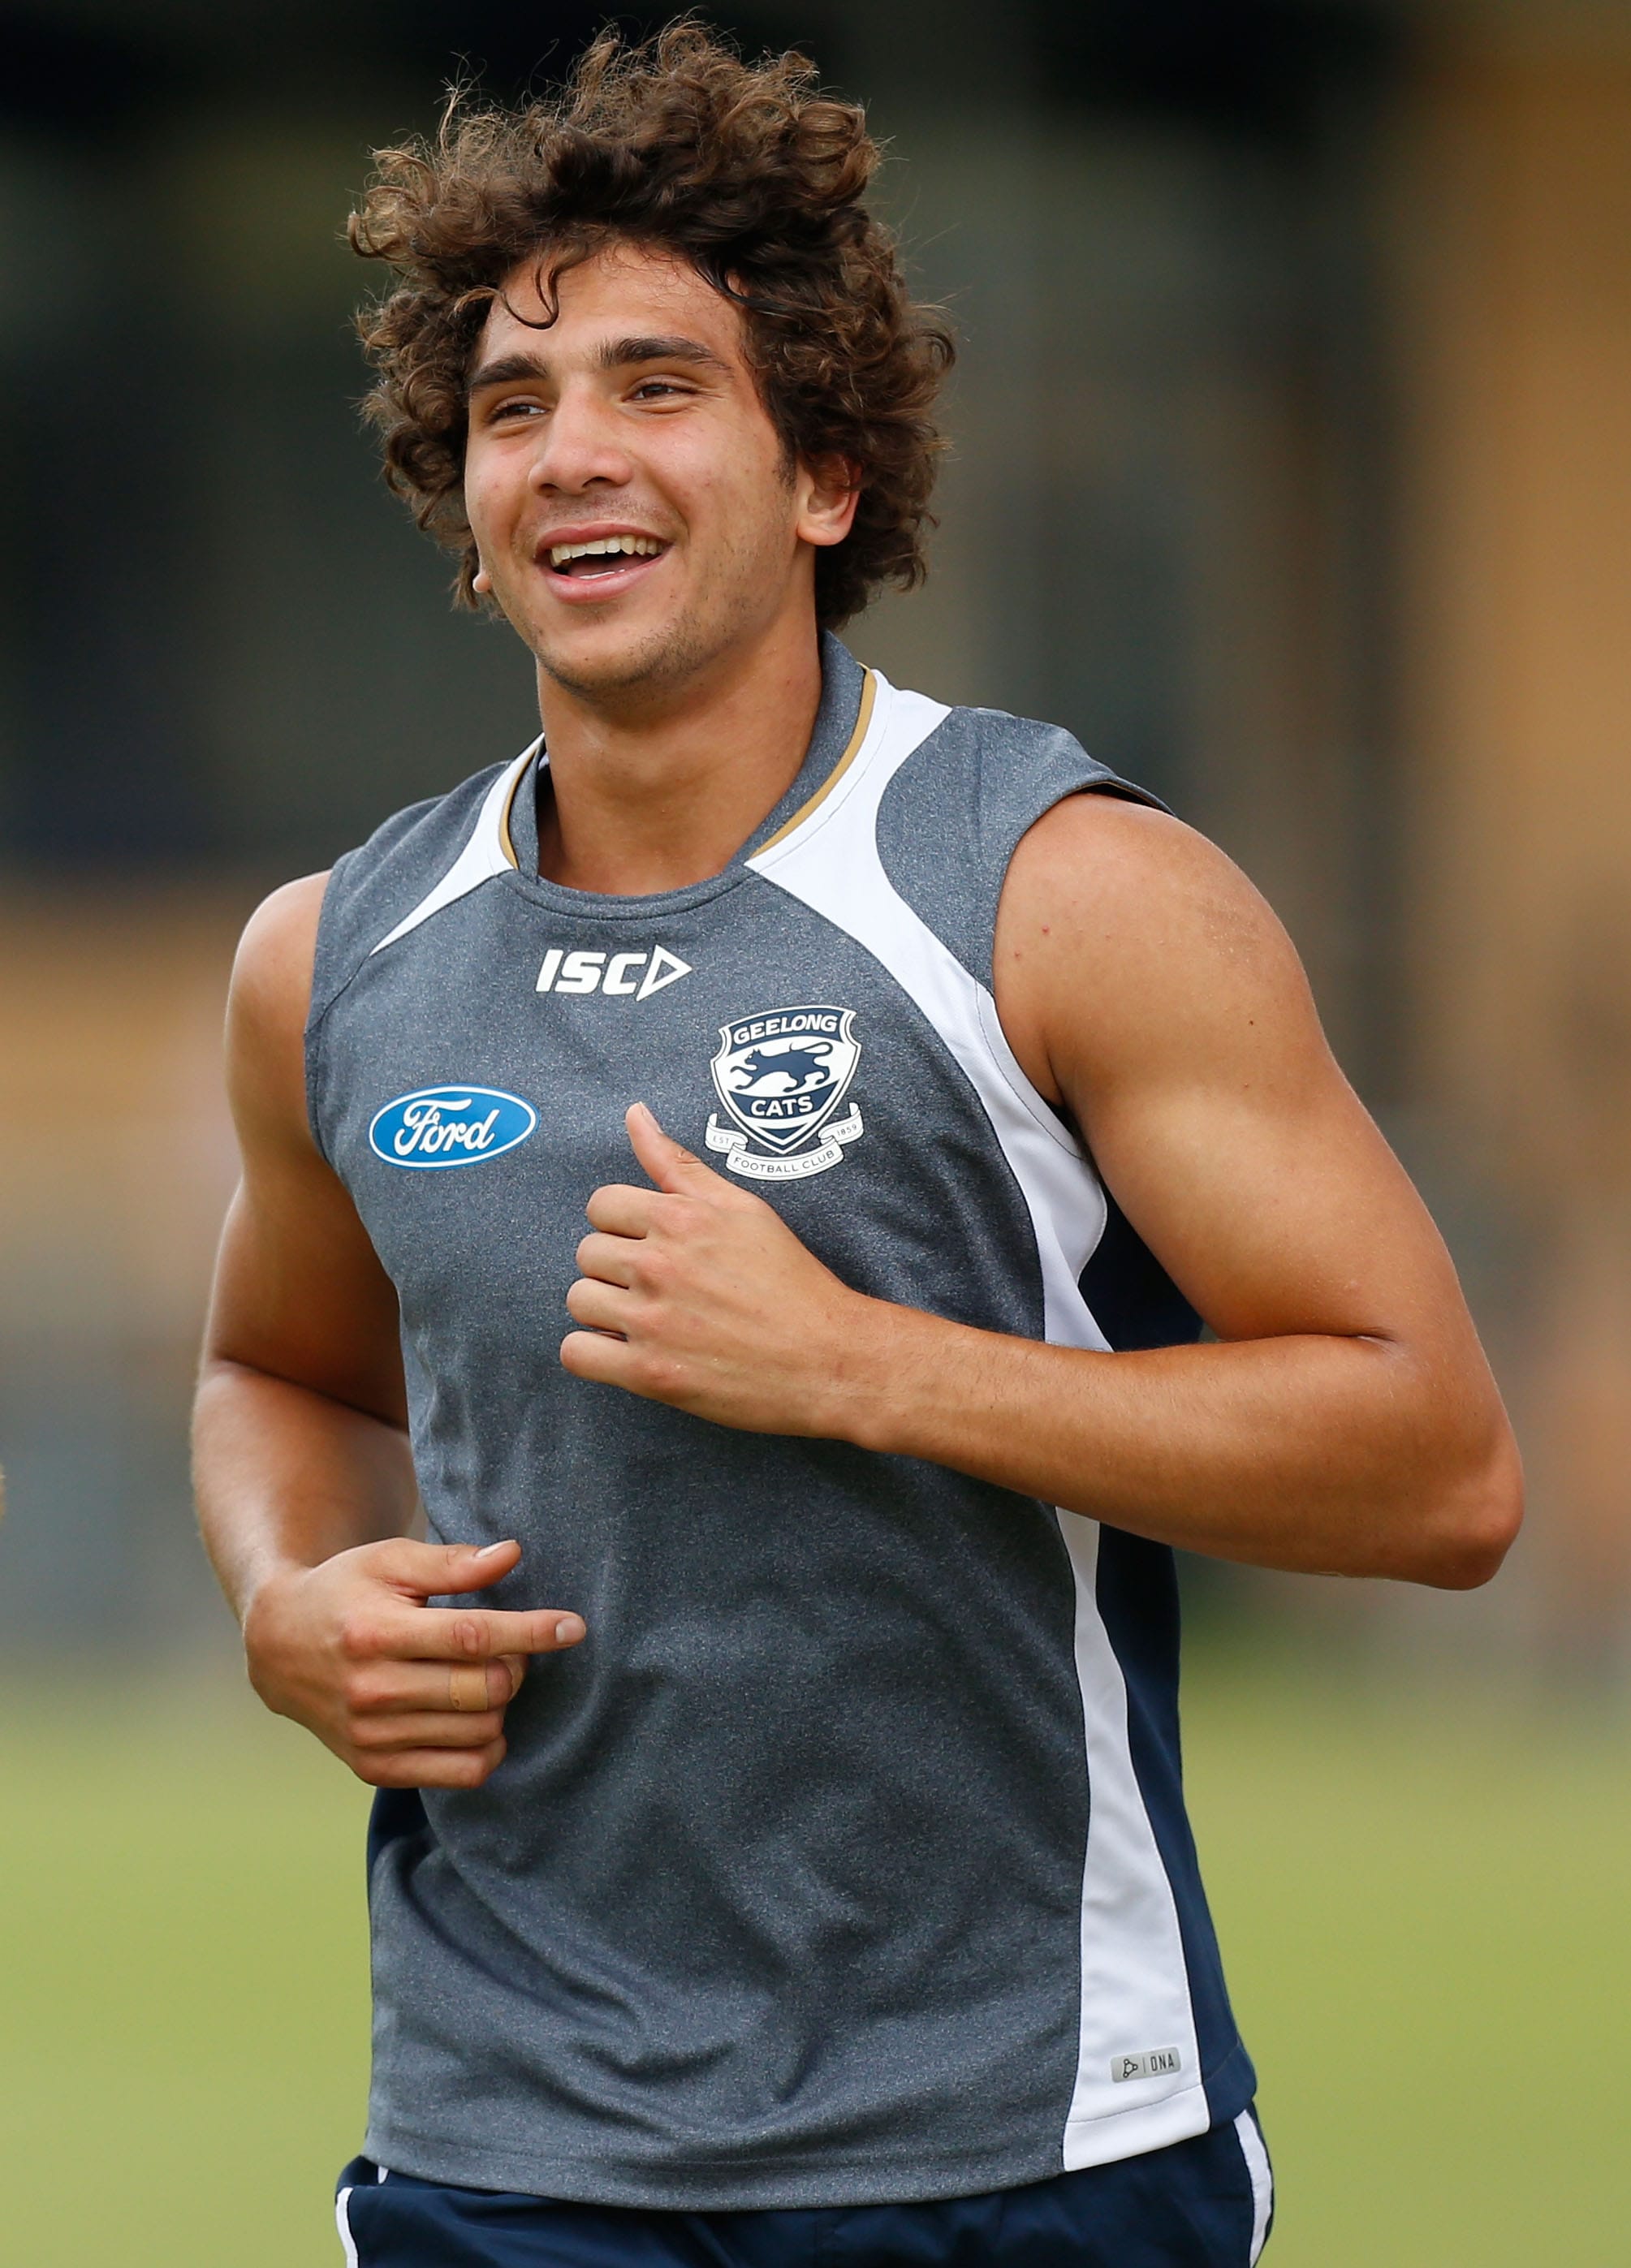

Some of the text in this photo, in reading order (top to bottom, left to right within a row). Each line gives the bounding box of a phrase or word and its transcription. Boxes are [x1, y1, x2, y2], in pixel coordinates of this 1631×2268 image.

[535, 949, 648, 995] ISC
[733, 1014, 838, 1045] GEELONG
[751, 1096, 813, 1117] CATS
[394, 1098, 500, 1156] Ford
[837, 1124, 857, 1137] 1859
[713, 1136, 729, 1145] EST
[734, 1149, 835, 1173] FOOTBALL CLUB
[1150, 2053, 1174, 2072] DNA
